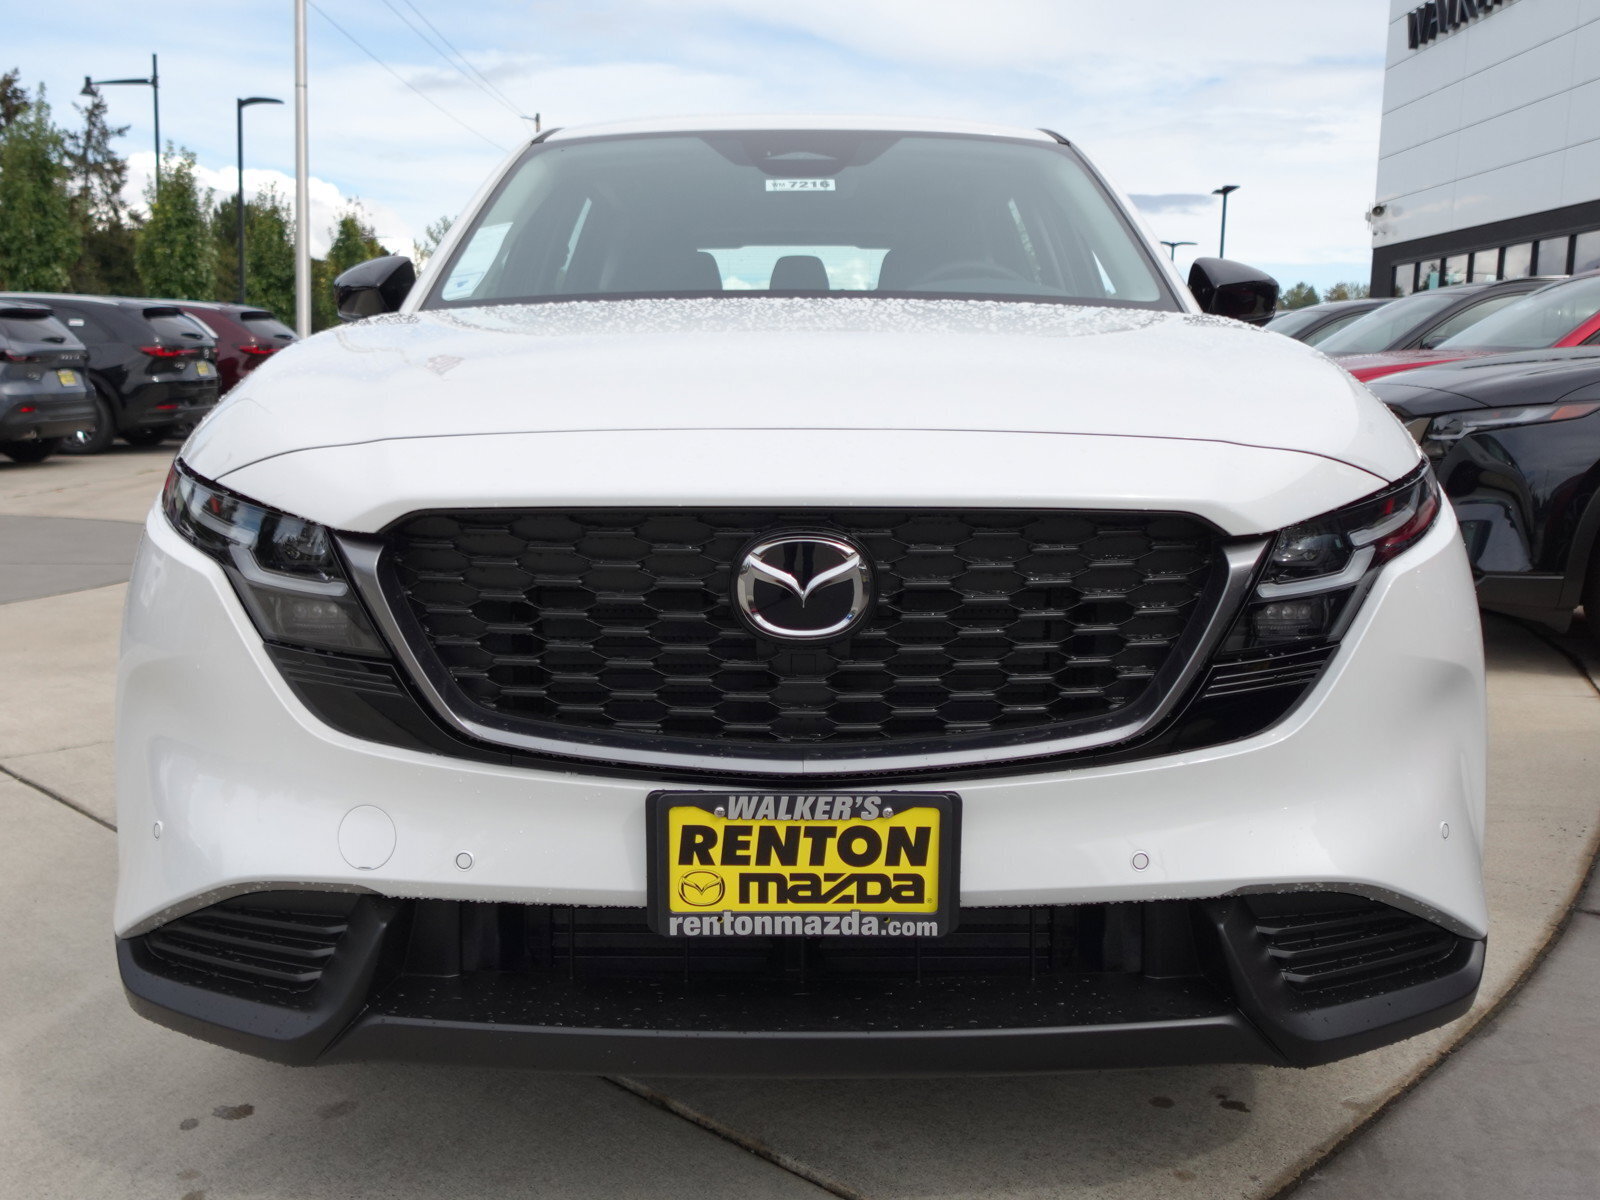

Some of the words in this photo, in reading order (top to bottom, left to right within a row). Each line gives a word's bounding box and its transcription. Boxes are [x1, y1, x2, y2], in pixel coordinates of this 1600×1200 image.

[788, 180, 831, 189] 7216
[727, 796, 882, 820] WALKER'S
[678, 825, 931, 867] RENTON
[669, 910, 938, 936] rentonmazda.com
